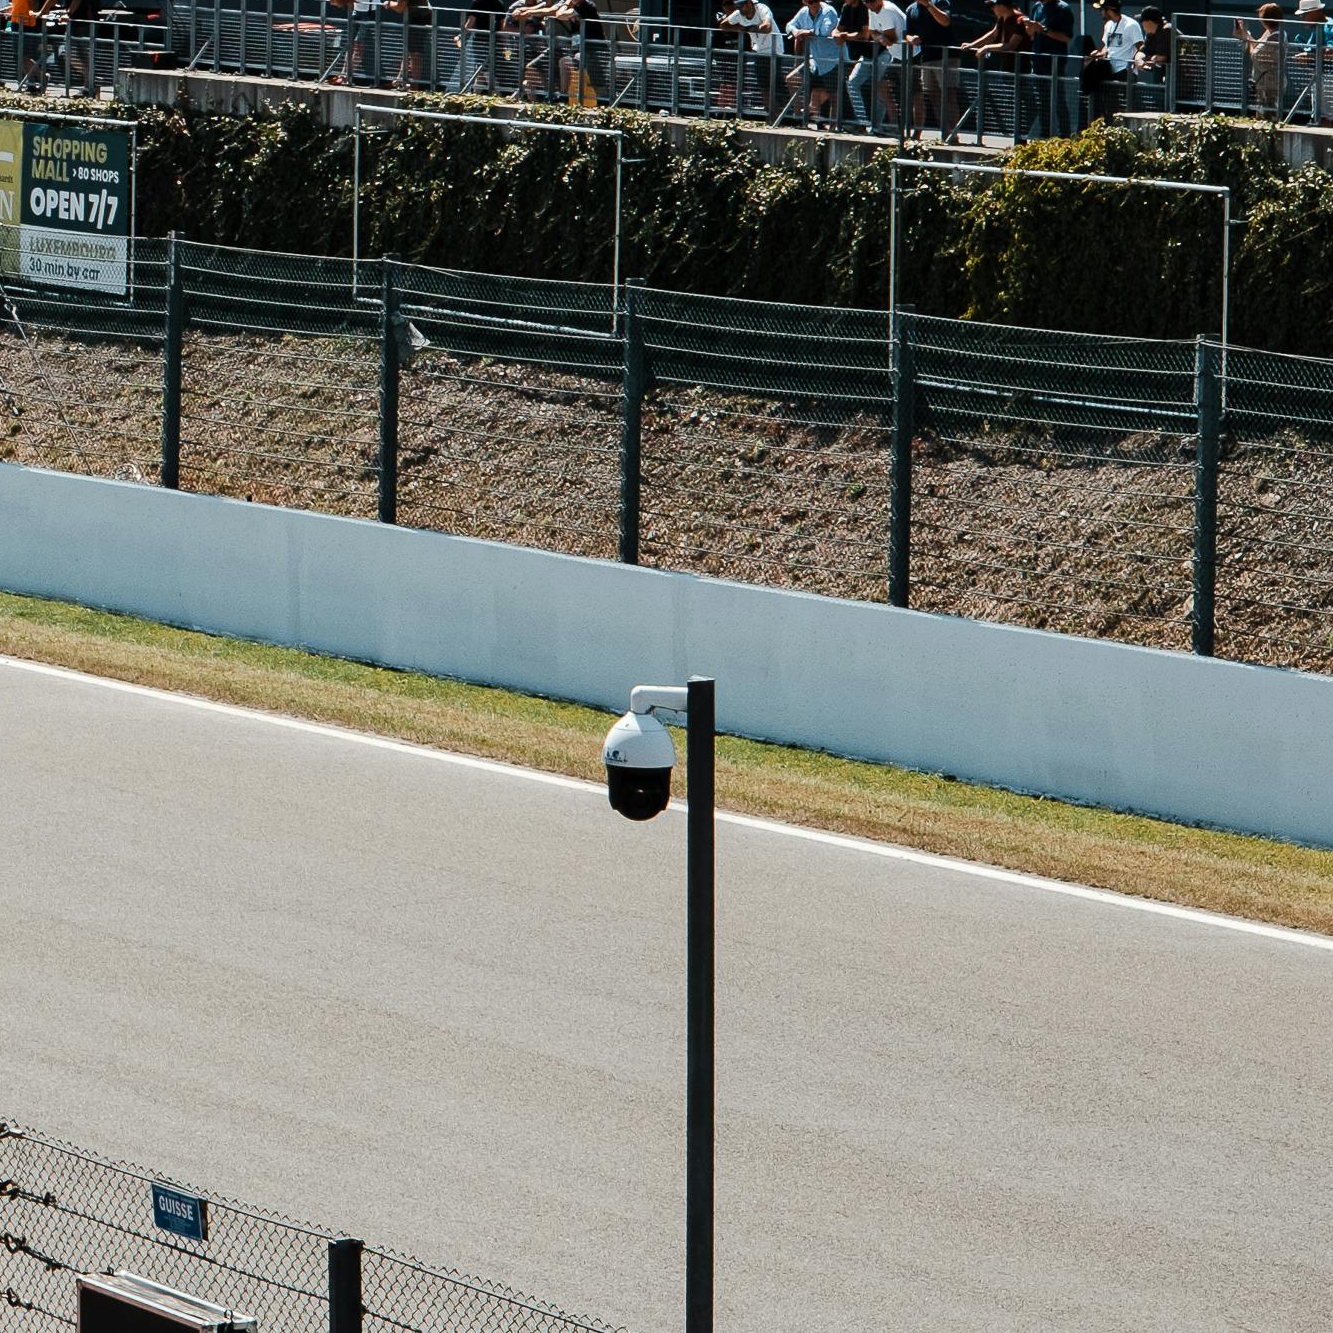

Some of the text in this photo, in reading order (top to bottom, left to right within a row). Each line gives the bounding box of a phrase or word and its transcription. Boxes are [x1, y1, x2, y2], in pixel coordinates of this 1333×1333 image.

[32, 135, 108, 164] SHOPPING
[31, 157, 70, 183] MALL
[90, 167, 120, 184] SHOPS
[29, 186, 119, 230] OPEN 7/7
[29, 256, 101, 281] 30 min by car
[158, 1194, 194, 1222] GUISSE
